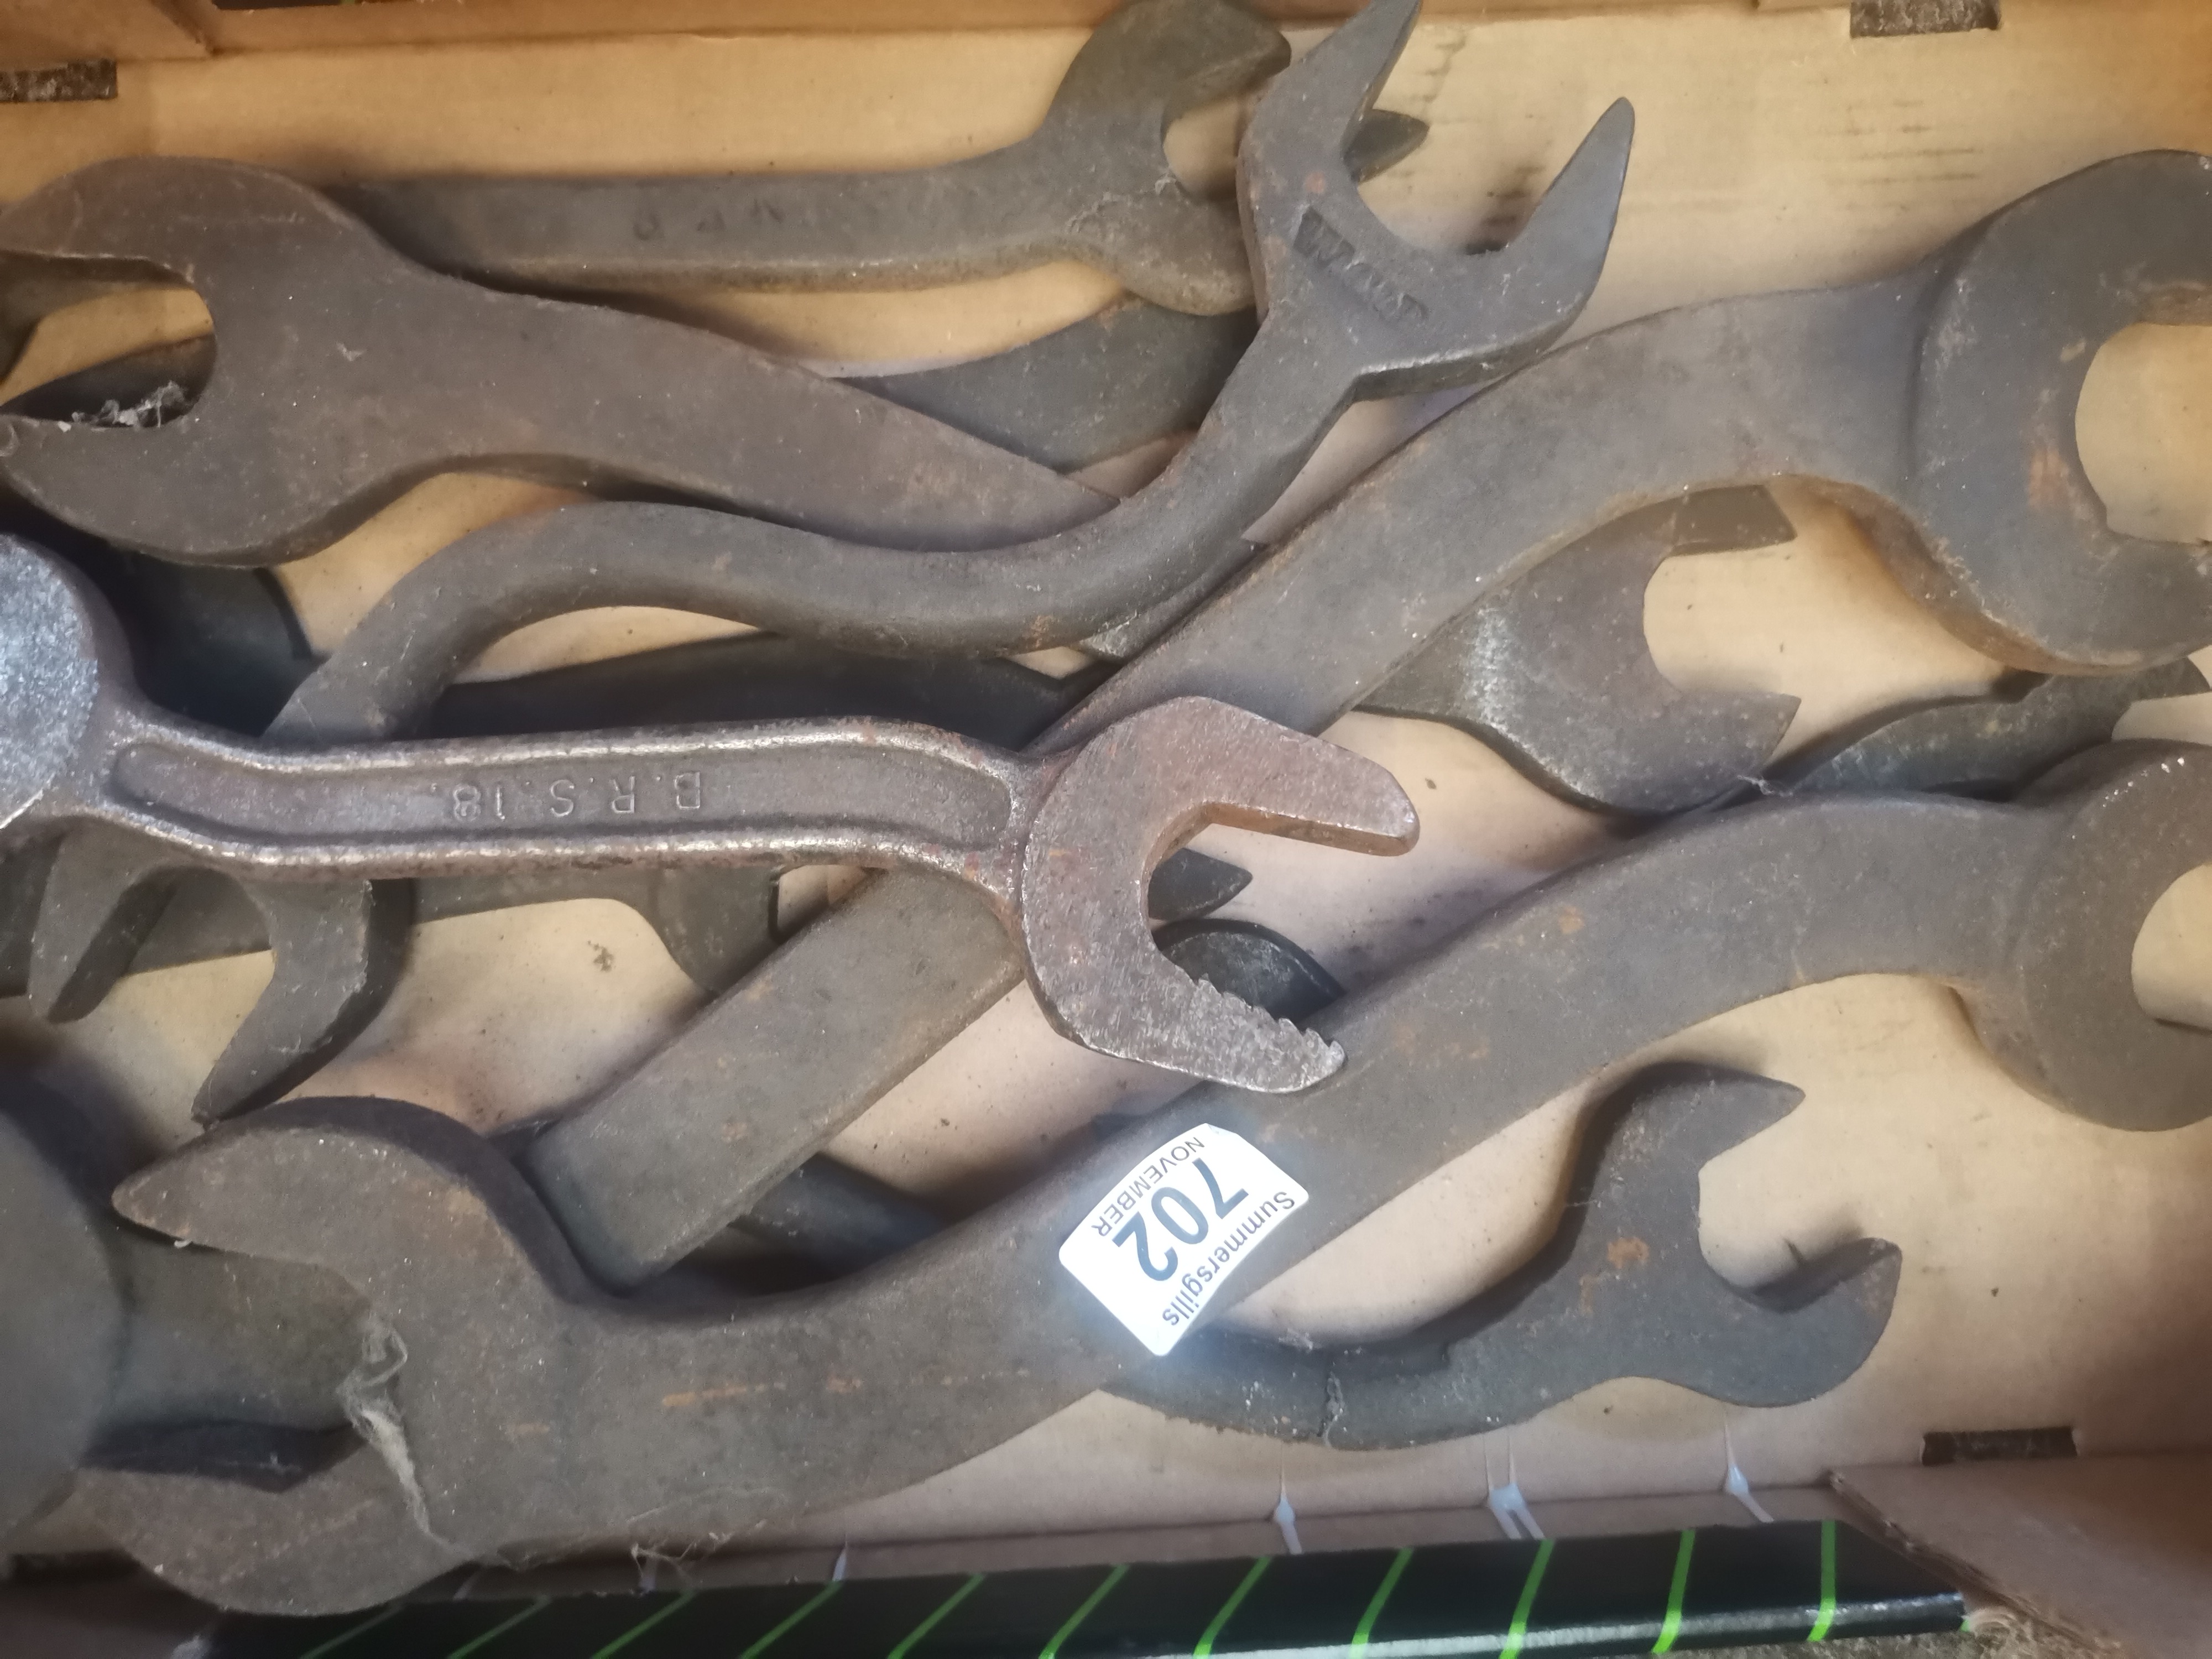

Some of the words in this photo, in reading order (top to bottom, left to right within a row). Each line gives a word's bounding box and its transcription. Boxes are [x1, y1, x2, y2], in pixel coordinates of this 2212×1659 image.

[1091, 1136, 1206, 1237] NOVEMBER
[1112, 1157, 1249, 1281] 702
[1162, 1191, 1295, 1326] Summersgills
